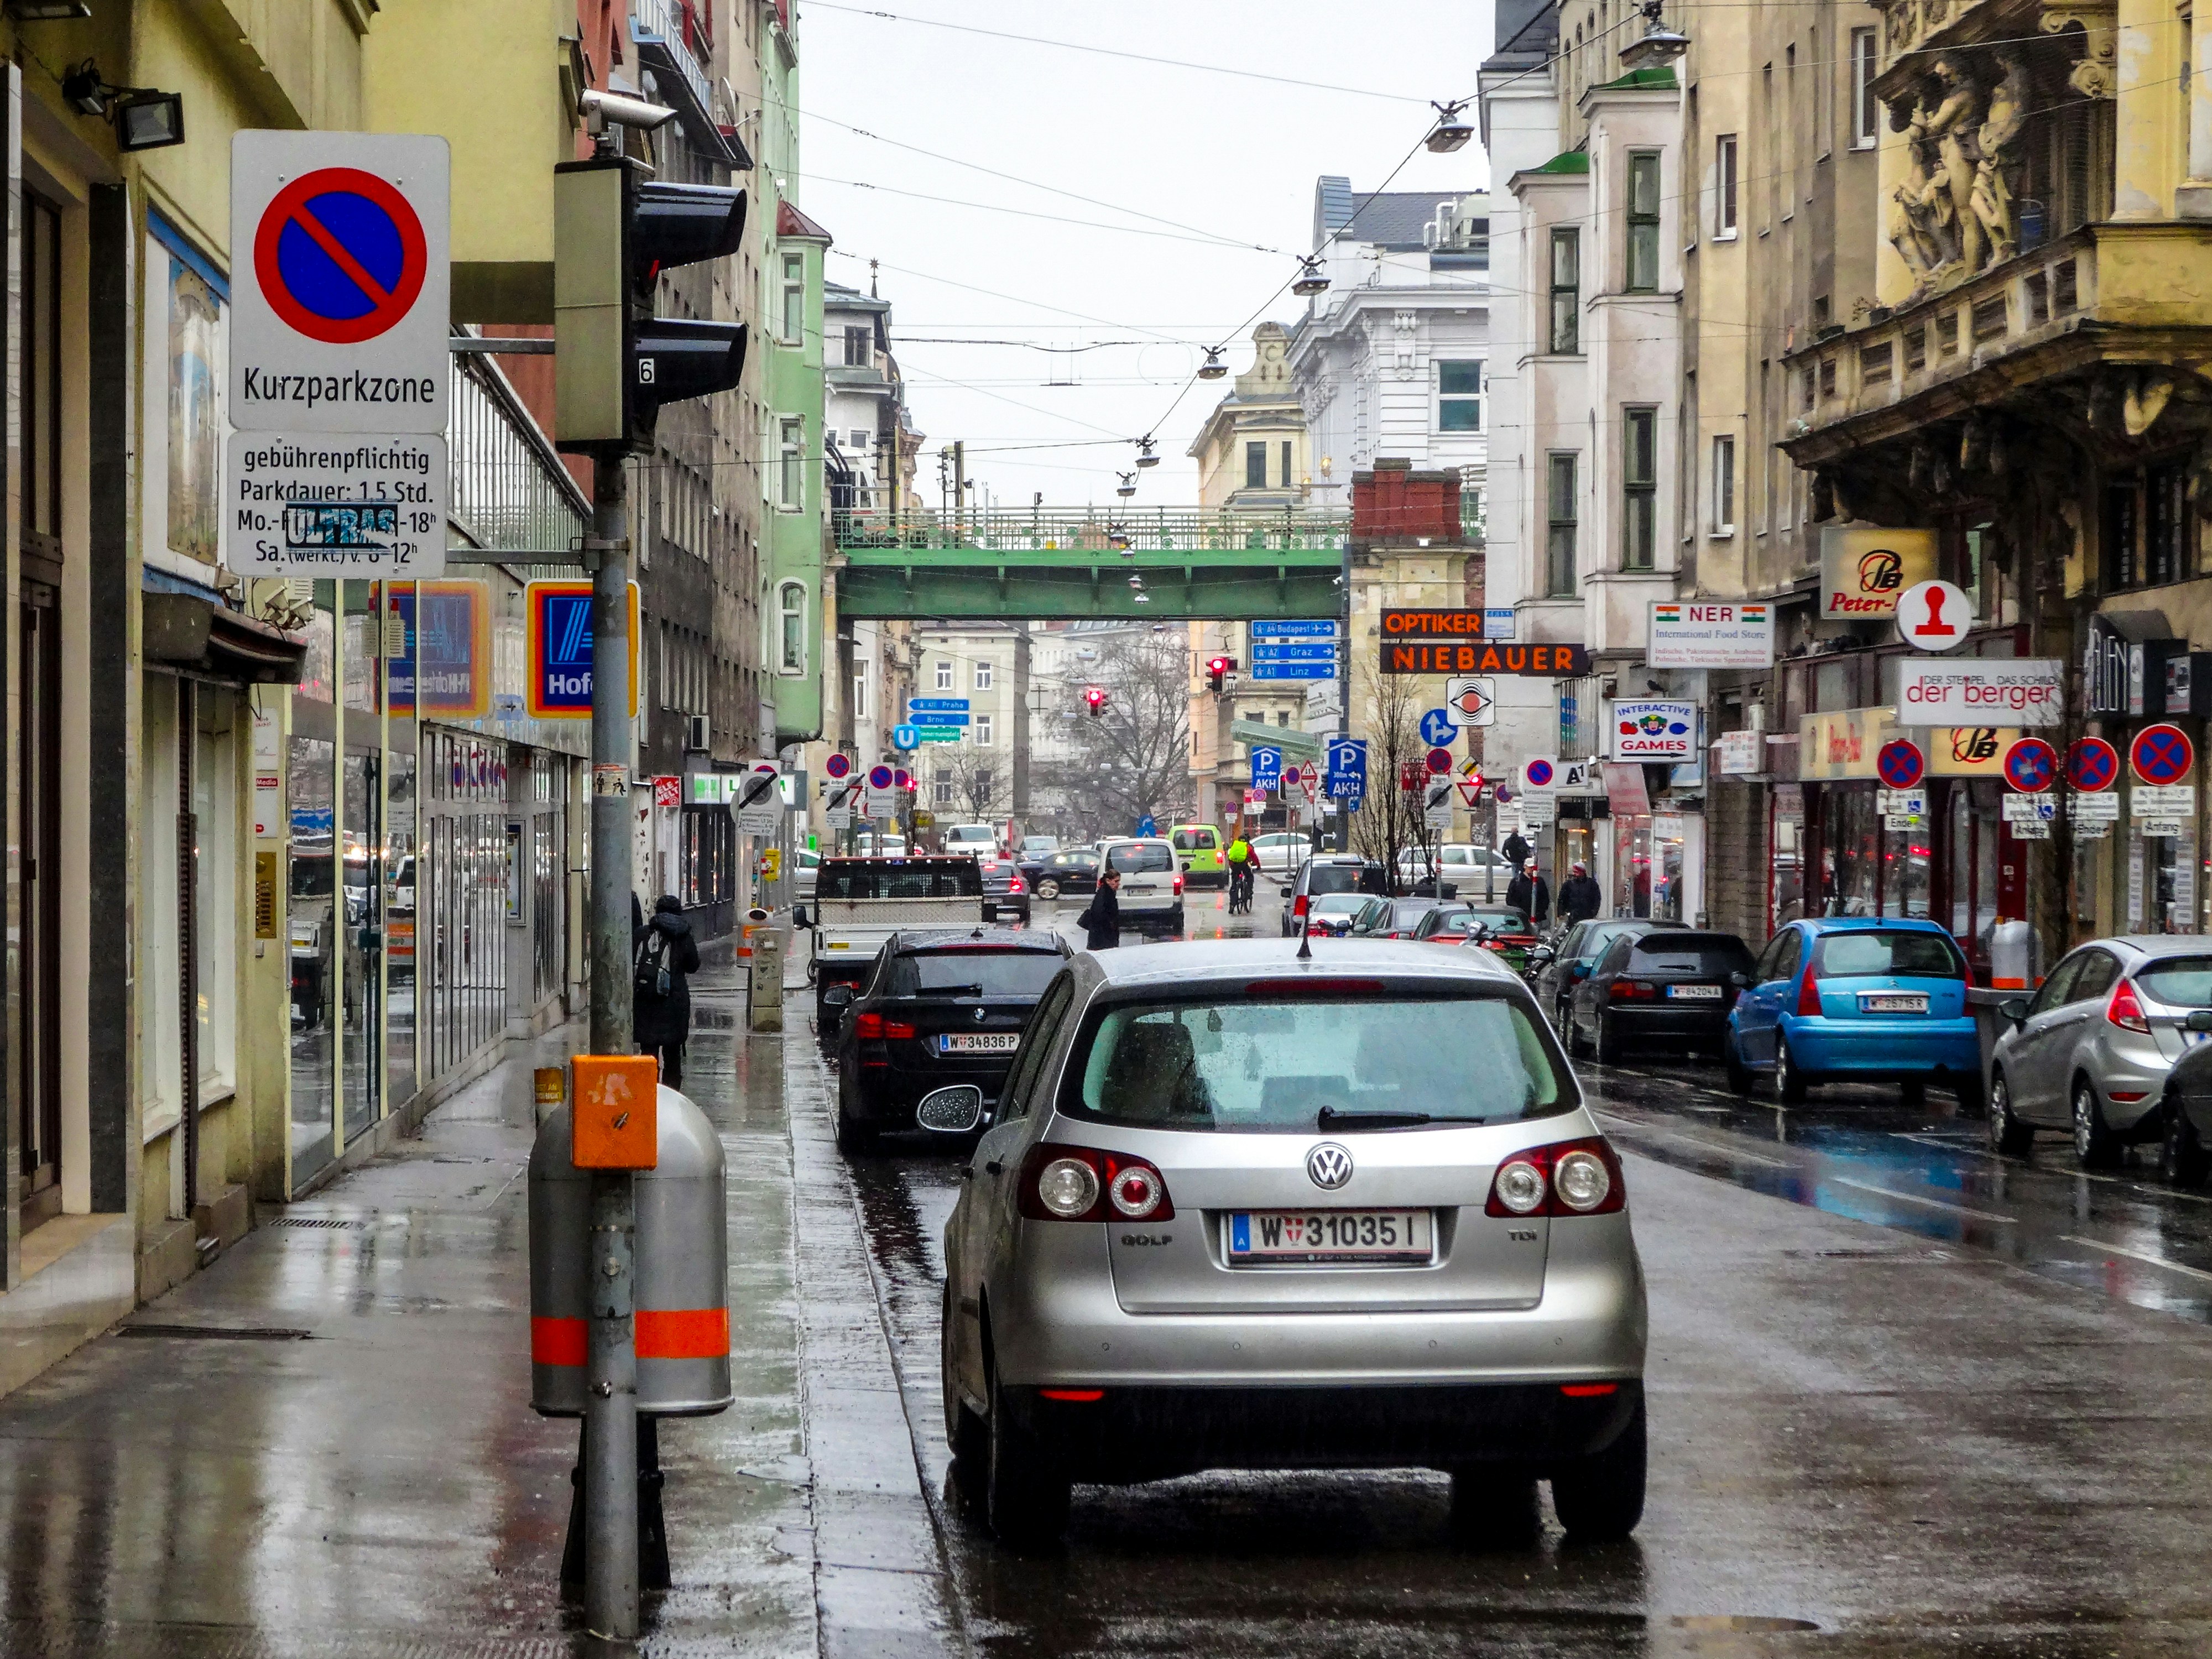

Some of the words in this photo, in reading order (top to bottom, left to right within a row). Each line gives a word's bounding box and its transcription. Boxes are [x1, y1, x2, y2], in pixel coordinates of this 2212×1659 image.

[640, 361, 652, 382] 6
[244, 368, 434, 408] Kurzparkzone
[244, 446, 429, 474] gebührenpflichtig
[241, 479, 351, 500] Parkdauer:
[394, 482, 434, 503] Std.
[256, 540, 285, 562] Sa.
[1385, 613, 1481, 633] OPTIKER
[1690, 607, 1733, 622] NER
[1277, 625, 1310, 634] Budapest
[1656, 630, 1712, 639] International
[1715, 630, 1738, 639] Food
[1741, 630, 1766, 639] Store
[1269, 648, 1278, 656] A2
[1291, 648, 1312, 656] Graz
[1393, 647, 1573, 670] NIEBAUER
[1267, 667, 1275, 675] A1
[1290, 666, 1309, 675] Linz
[549, 672, 593, 695] Hof
[1923, 675, 1943, 685] DER
[1997, 675, 2017, 685] DAS
[1907, 676, 1953, 703] der
[1964, 676, 2057, 710] berger
[1617, 704, 1691, 717] INTERACTIVE
[898, 729, 915, 747] U
[1621, 740, 1687, 750] GAMES
[1260, 753, 1273, 770] P
[1340, 748, 1357, 770] P
[1566, 764, 1584, 785] A1
[1255, 779, 1276, 789] AKH
[1333, 782, 1360, 795] AKH
[950, 1036, 958, 1048] W
[968, 1036, 1005, 1048] 34836
[1008, 1036, 1015, 1047] P
[1261, 1217, 1281, 1247] W
[1306, 1217, 1396, 1246] 31035
